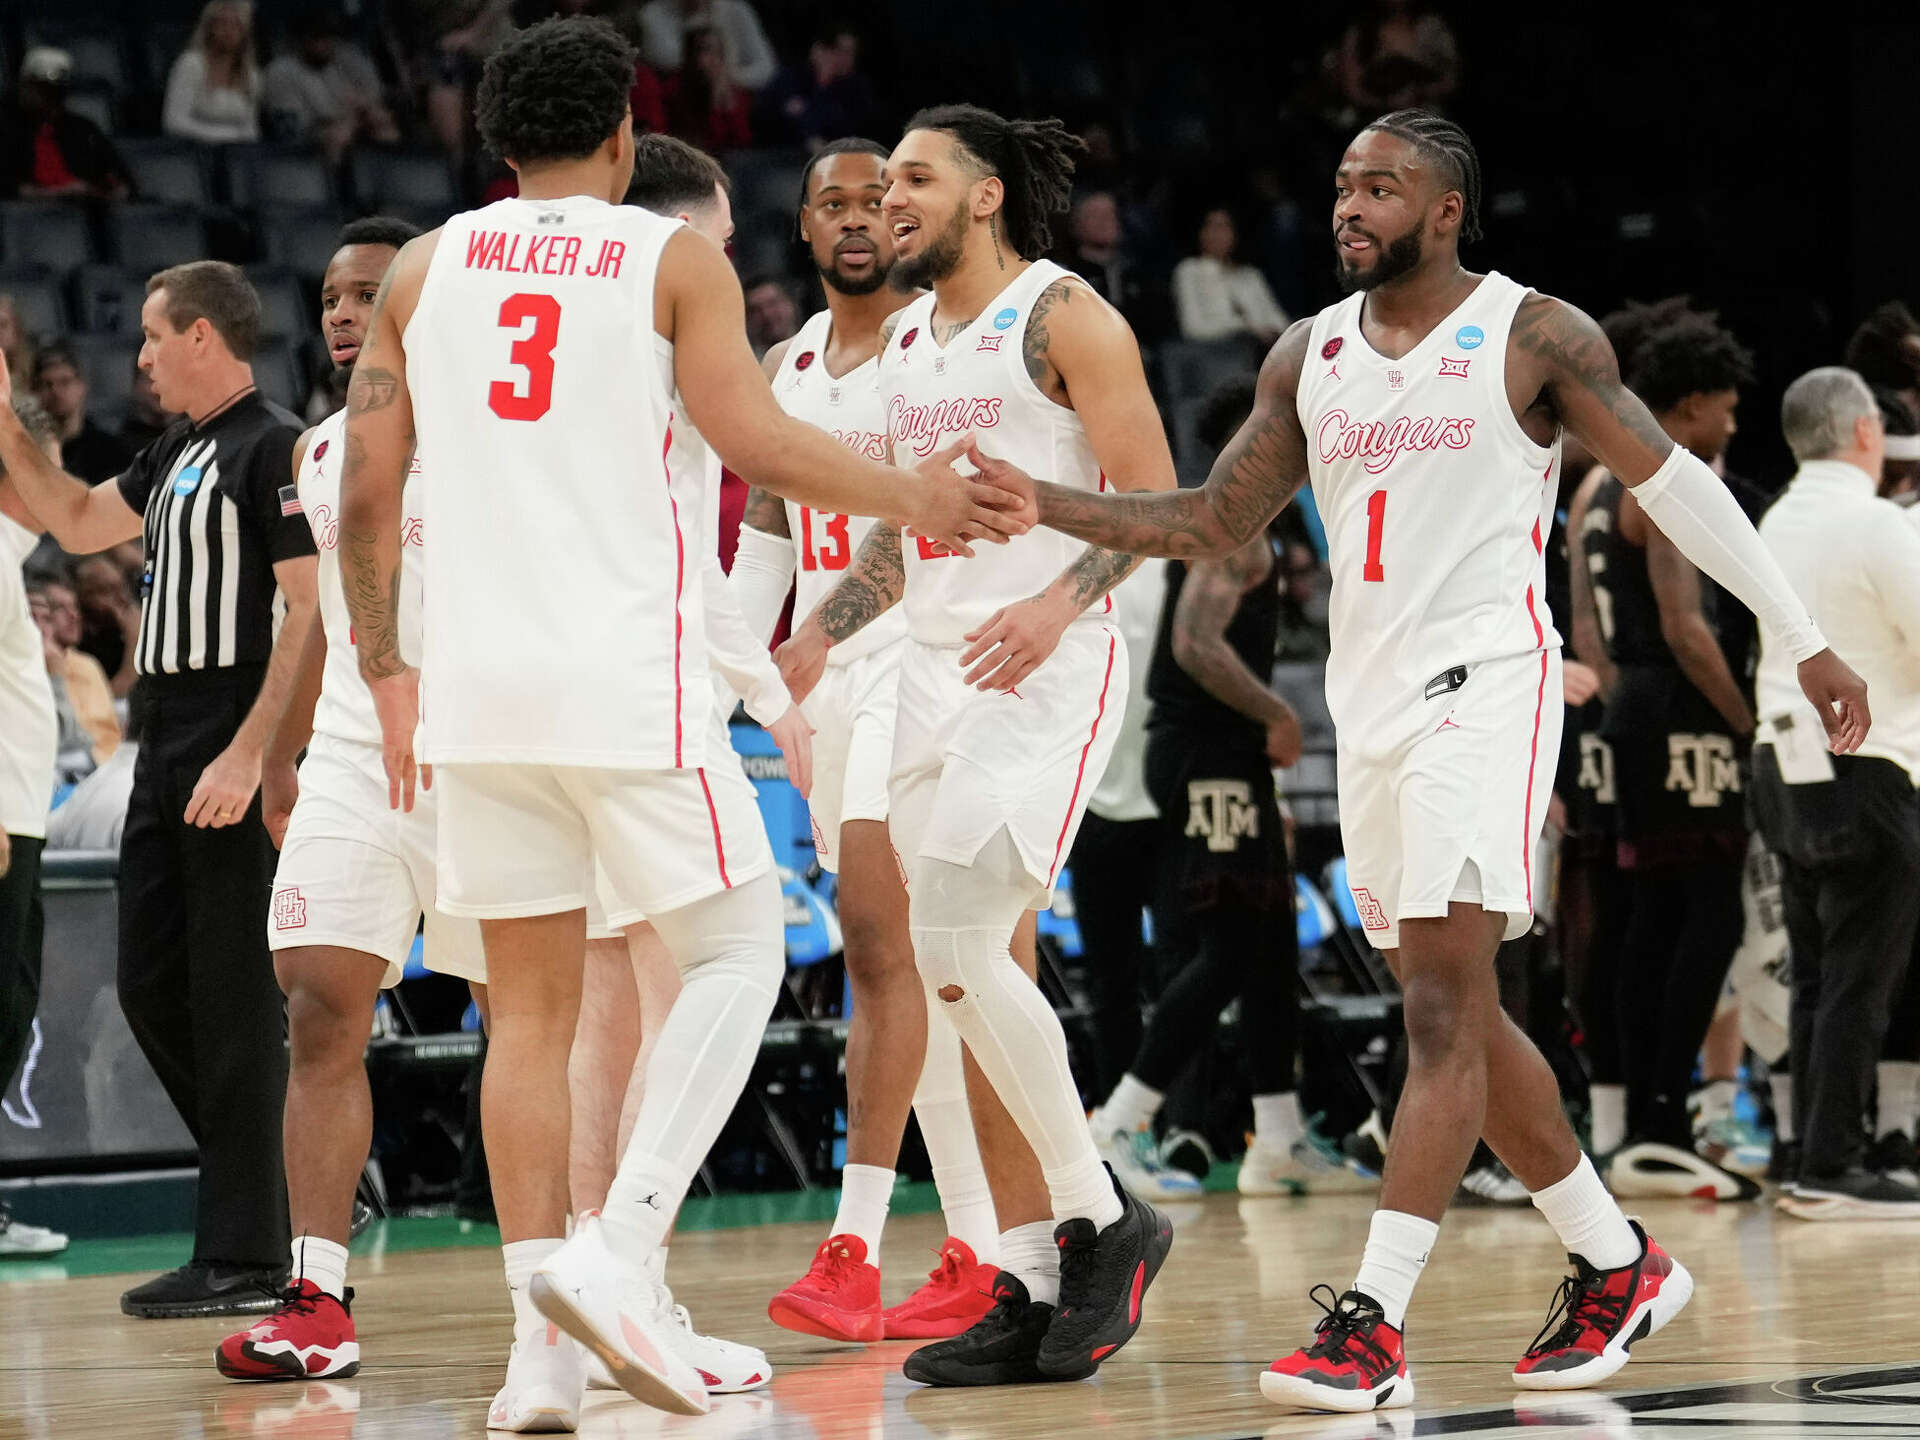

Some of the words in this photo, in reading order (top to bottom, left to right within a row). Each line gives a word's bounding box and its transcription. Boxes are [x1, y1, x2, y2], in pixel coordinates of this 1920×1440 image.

[465, 230, 582, 276] WALKER
[585, 239, 626, 279] JR
[488, 293, 562, 422] 3
[887, 394, 1002, 457] Cougars
[1316, 408, 1476, 475] Cougars
[801, 506, 851, 571] 13
[1363, 490, 1387, 582] 1
[1454, 673, 1462, 684] L
